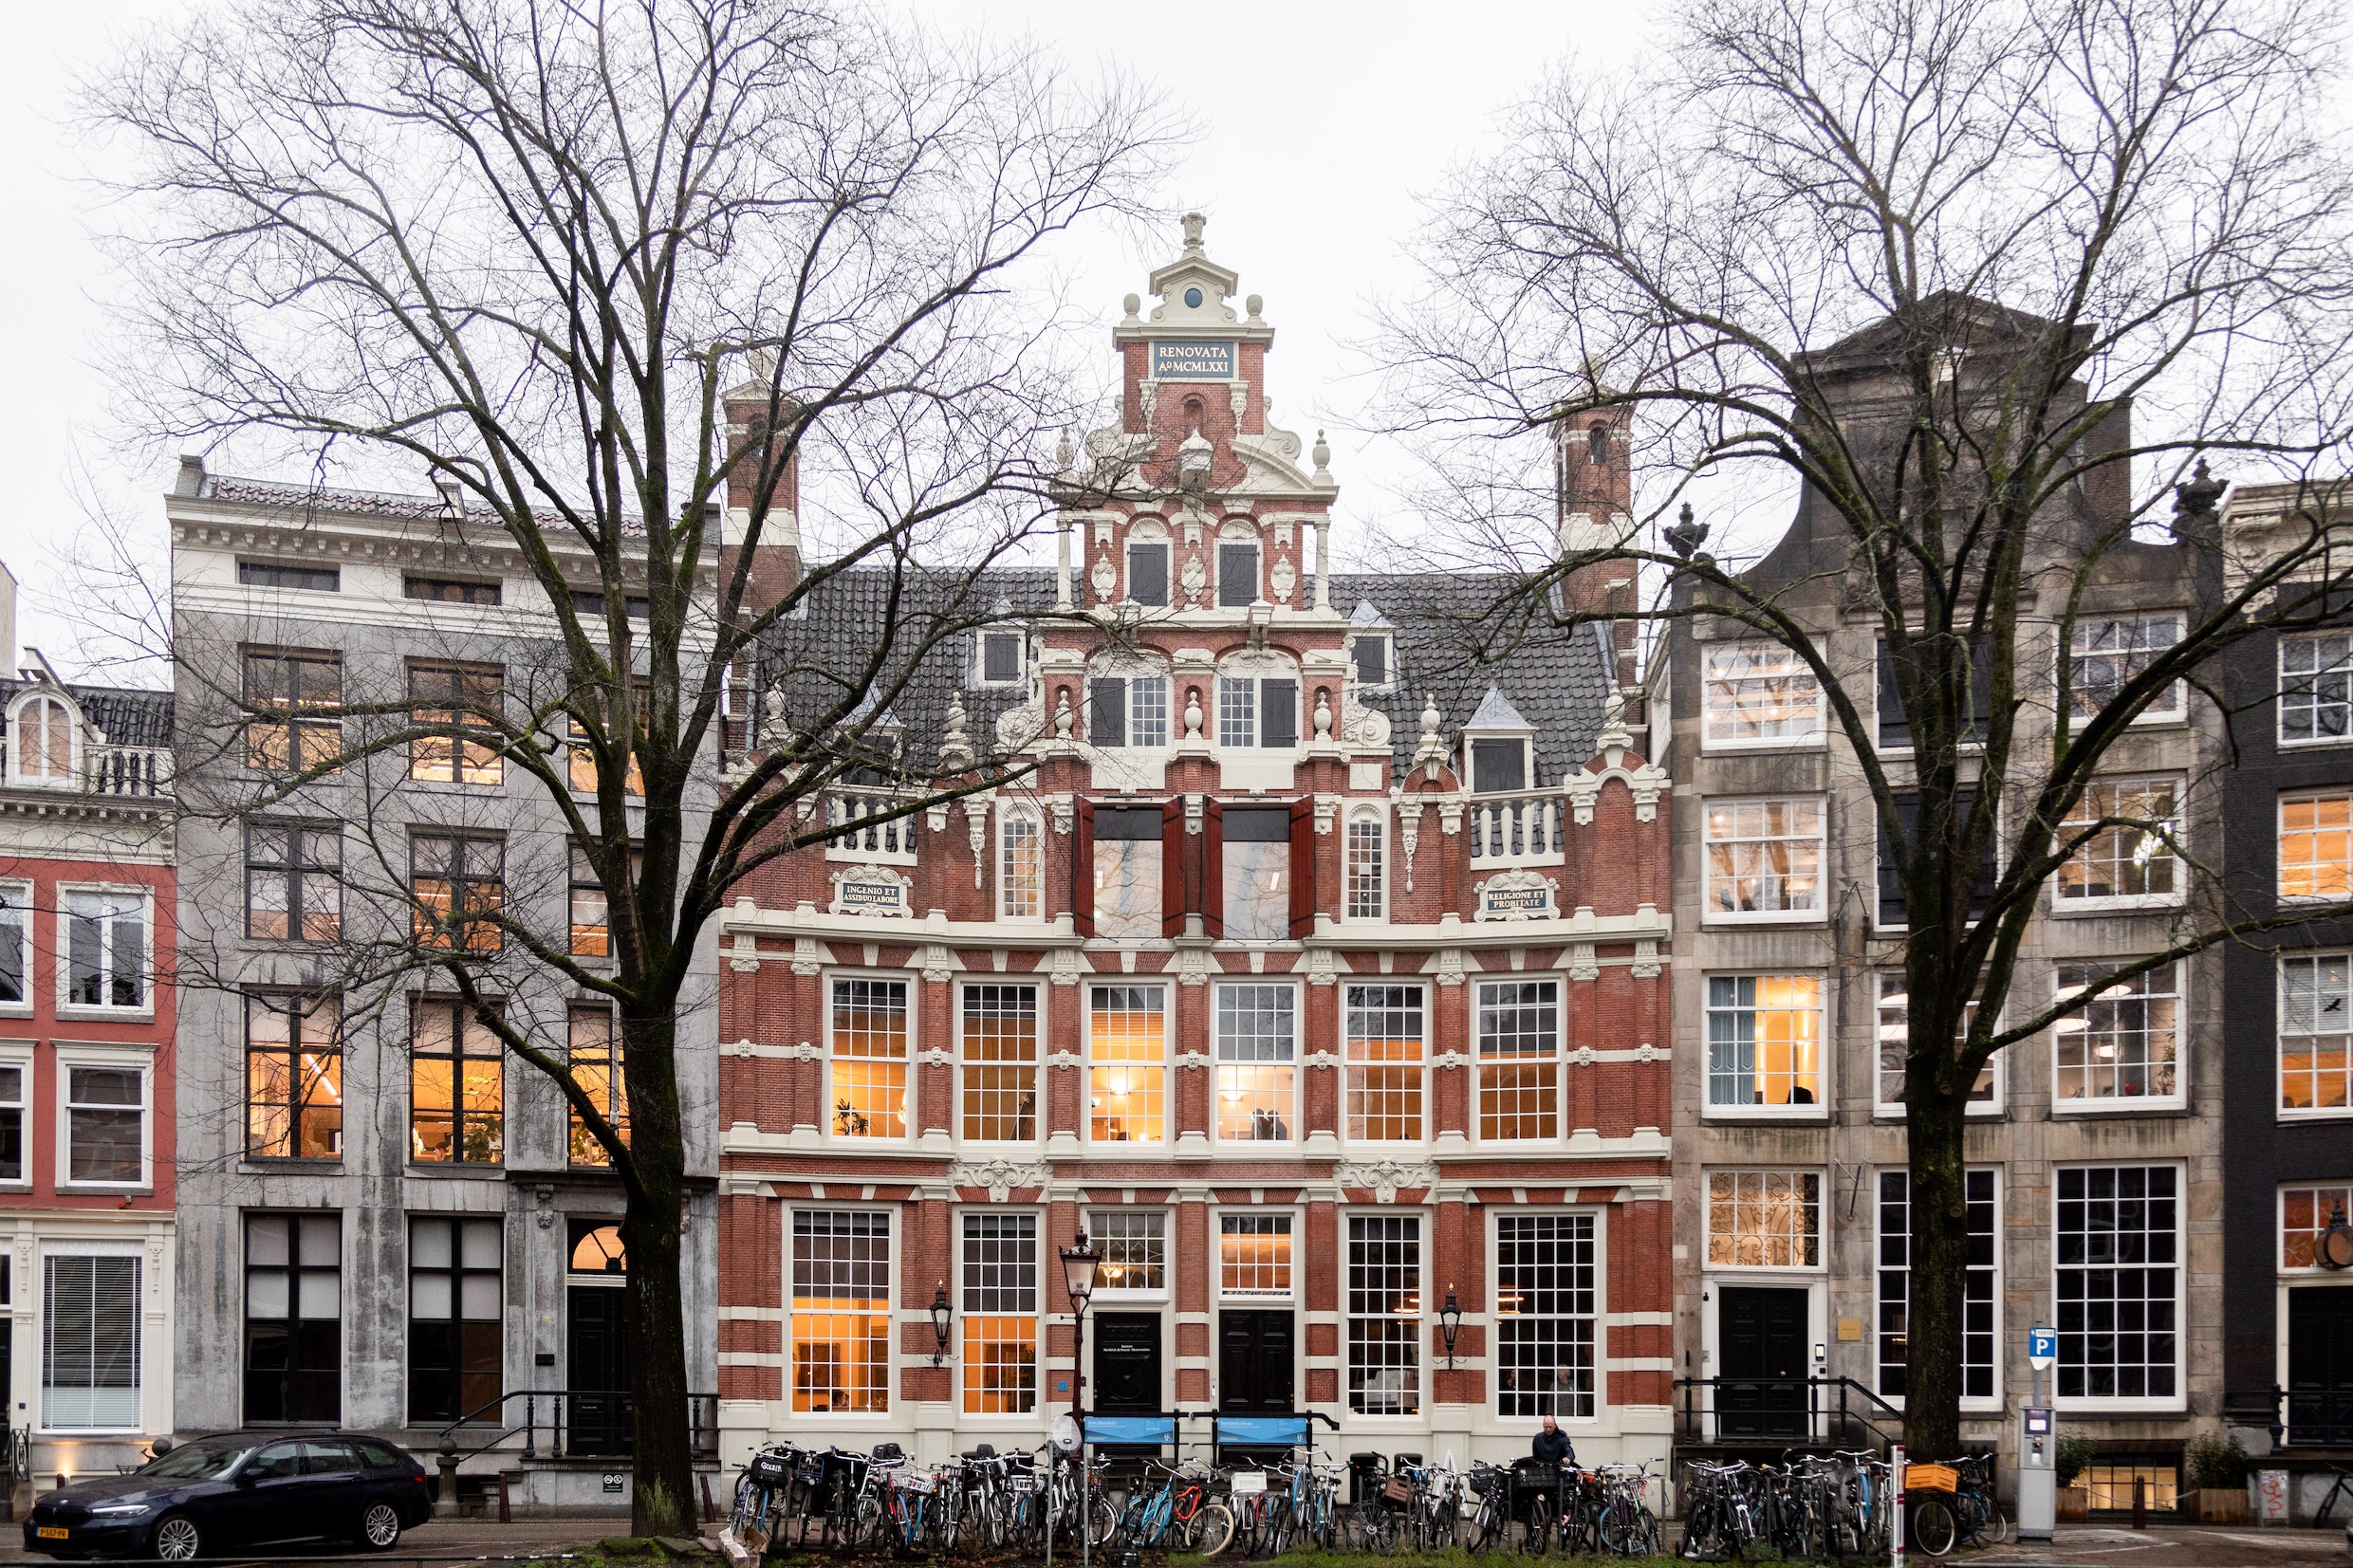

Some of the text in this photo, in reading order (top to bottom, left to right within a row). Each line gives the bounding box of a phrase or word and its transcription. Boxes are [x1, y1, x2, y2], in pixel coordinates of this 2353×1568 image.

[1159, 347, 1229, 358] RENOVATA
[1173, 361, 1229, 372] MCMLXXI
[847, 885, 897, 896] INGENIO ET
[1489, 892, 1532, 900] RELIGIONE
[843, 894, 899, 904] ASSIDUO LABORE
[1493, 899, 1541, 908] PROBITATE
[2036, 1338, 2048, 1356] P
